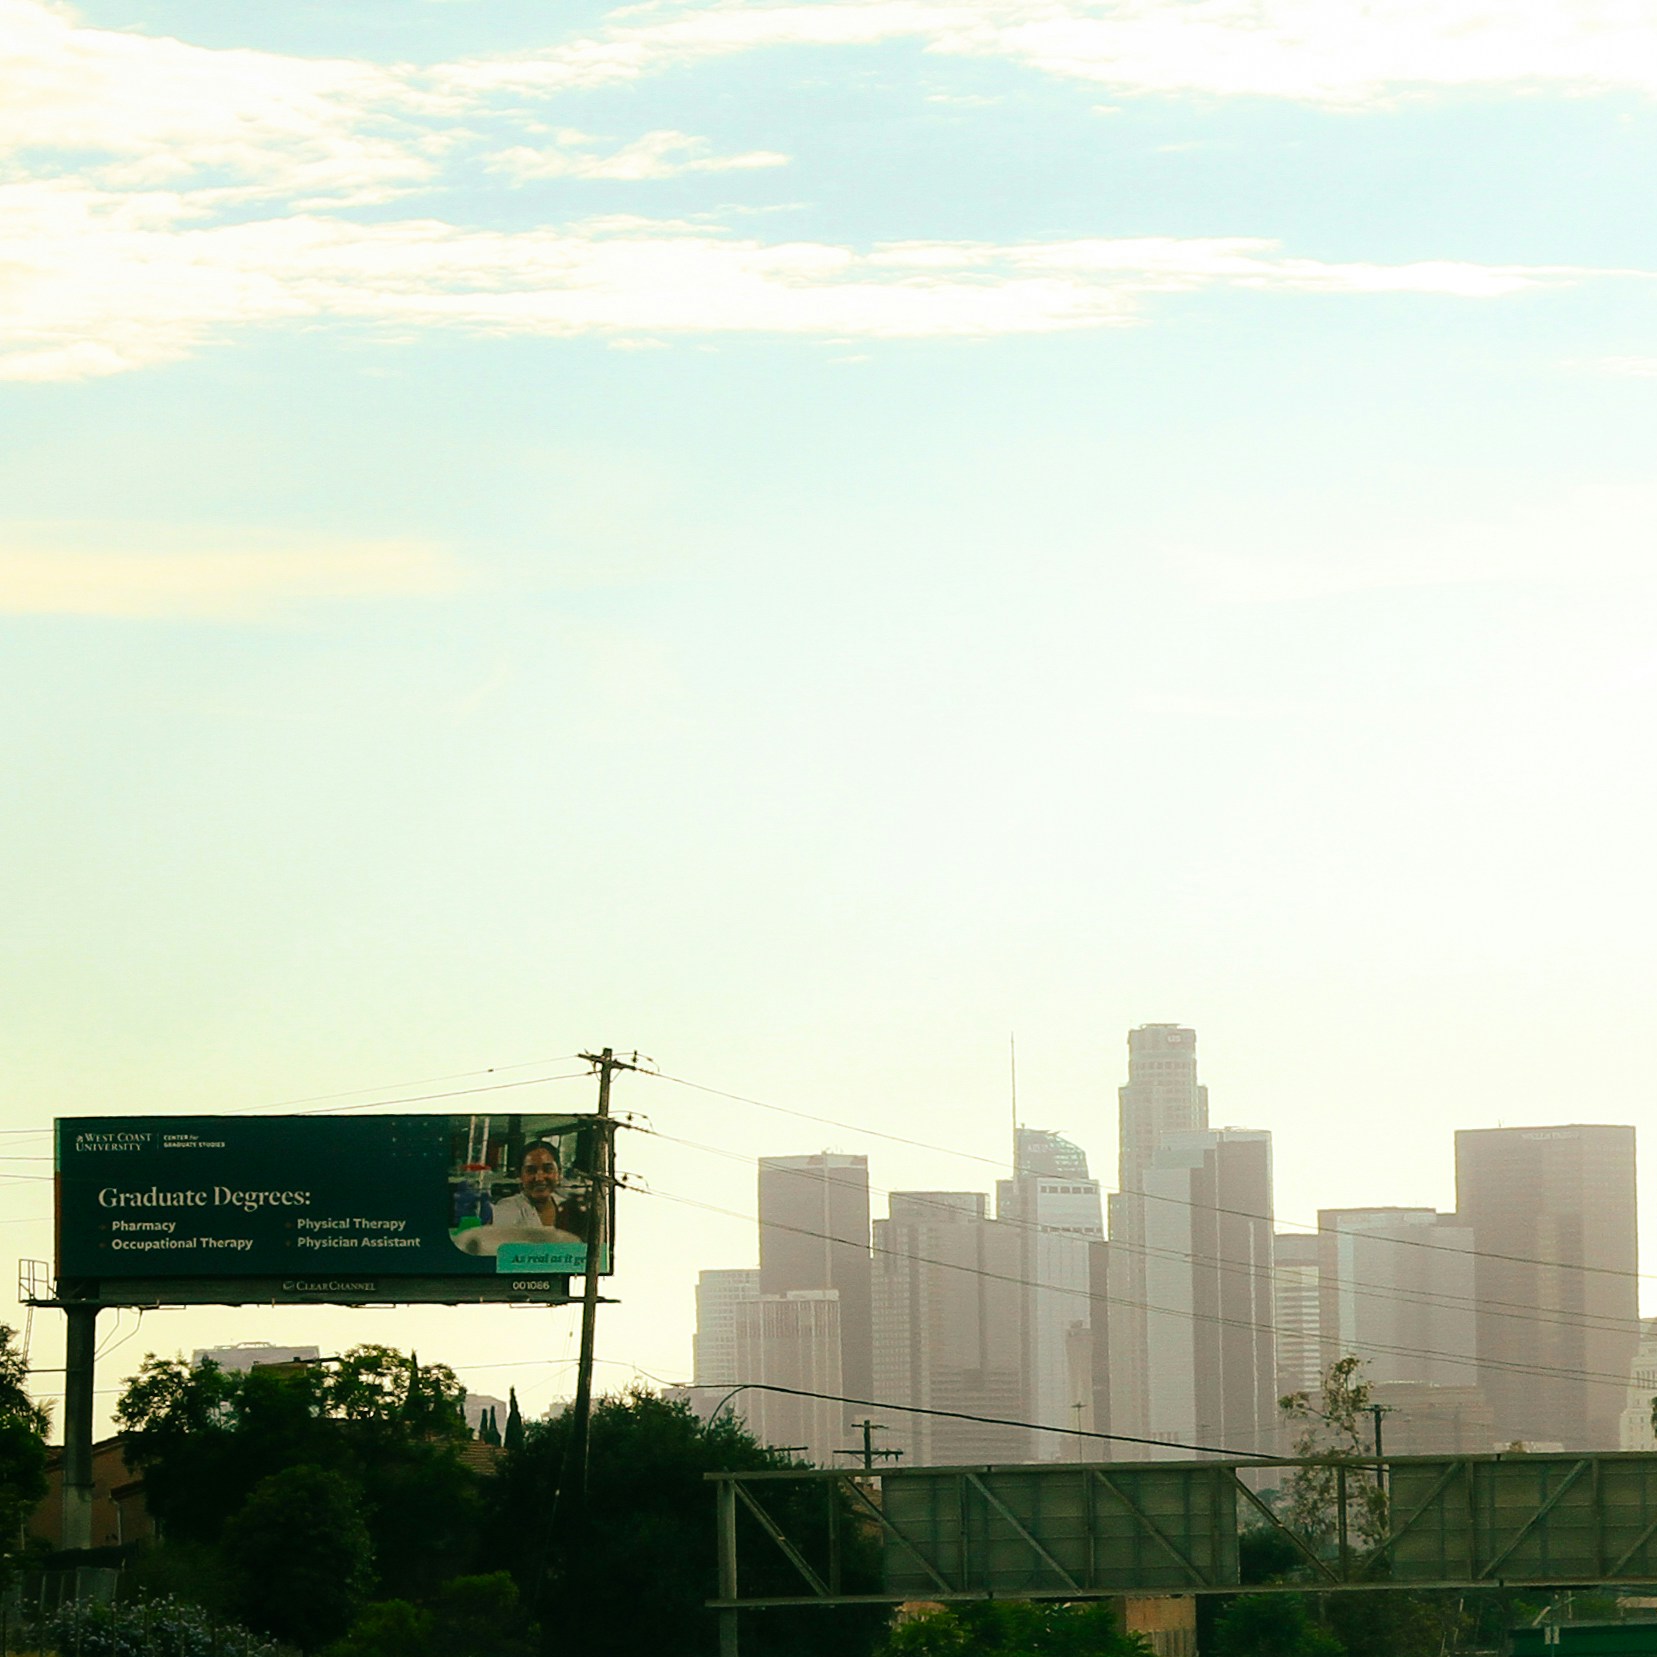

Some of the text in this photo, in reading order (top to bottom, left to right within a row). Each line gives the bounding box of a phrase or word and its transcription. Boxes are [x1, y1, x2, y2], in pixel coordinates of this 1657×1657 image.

[85, 1132, 151, 1142] WEST COAST
[75, 1143, 141, 1151] UNIVERSITY
[98, 1186, 311, 1212] Graduate Degrees:
[112, 1221, 176, 1233] Pharmacy
[297, 1218, 406, 1231] Physical Therapy
[112, 1237, 253, 1251] Occupational Therapy
[297, 1236, 421, 1250] Physician Assistant
[527, 1253, 548, 1263] real
[551, 1255, 562, 1263] as
[565, 1253, 573, 1263] it
[512, 1281, 550, 1290] 001086
